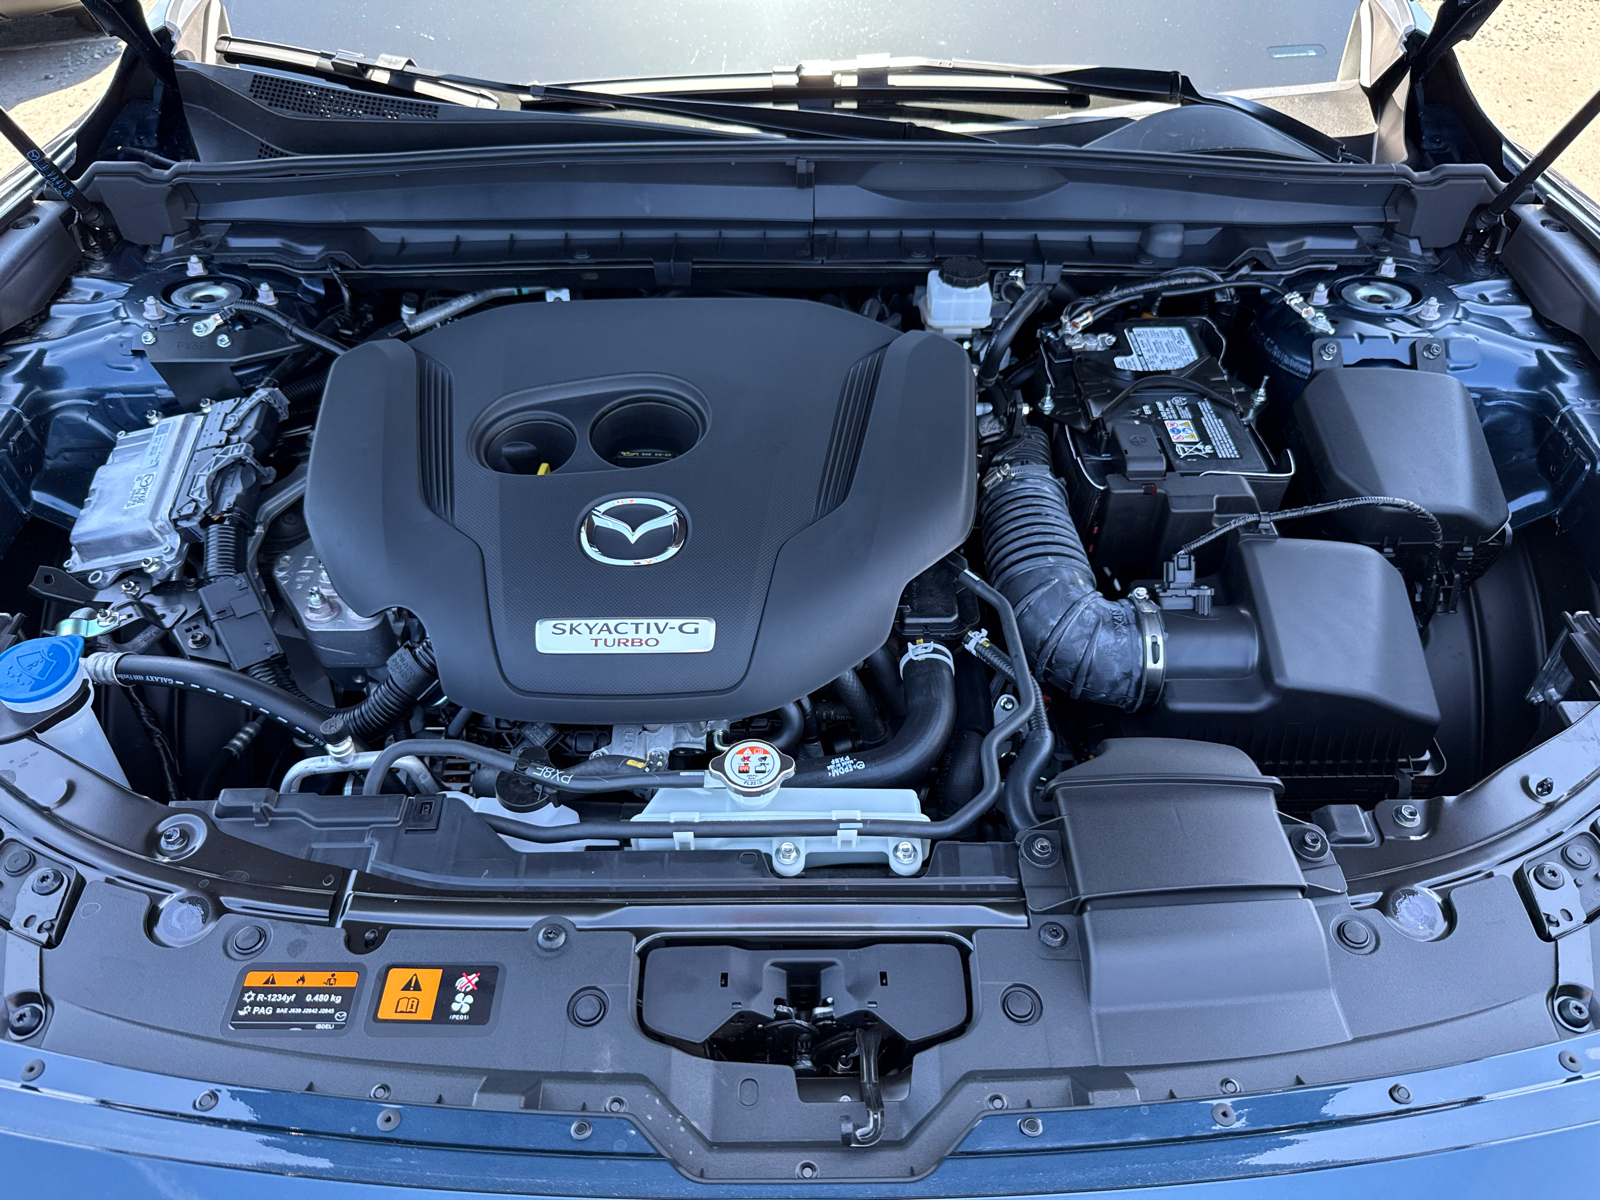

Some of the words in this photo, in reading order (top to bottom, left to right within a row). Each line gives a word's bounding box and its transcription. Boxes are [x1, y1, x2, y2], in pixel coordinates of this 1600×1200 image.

[551, 622, 700, 636] SKYACTIV-G
[590, 637, 660, 648] TURBO
[145, 675, 174, 685] GALAXY
[532, 766, 574, 784] PX8F
[256, 993, 297, 1004] R-1234yf
[305, 993, 329, 1003] 0.480
[329, 994, 342, 1004] kg
[252, 1006, 273, 1015] PAG
